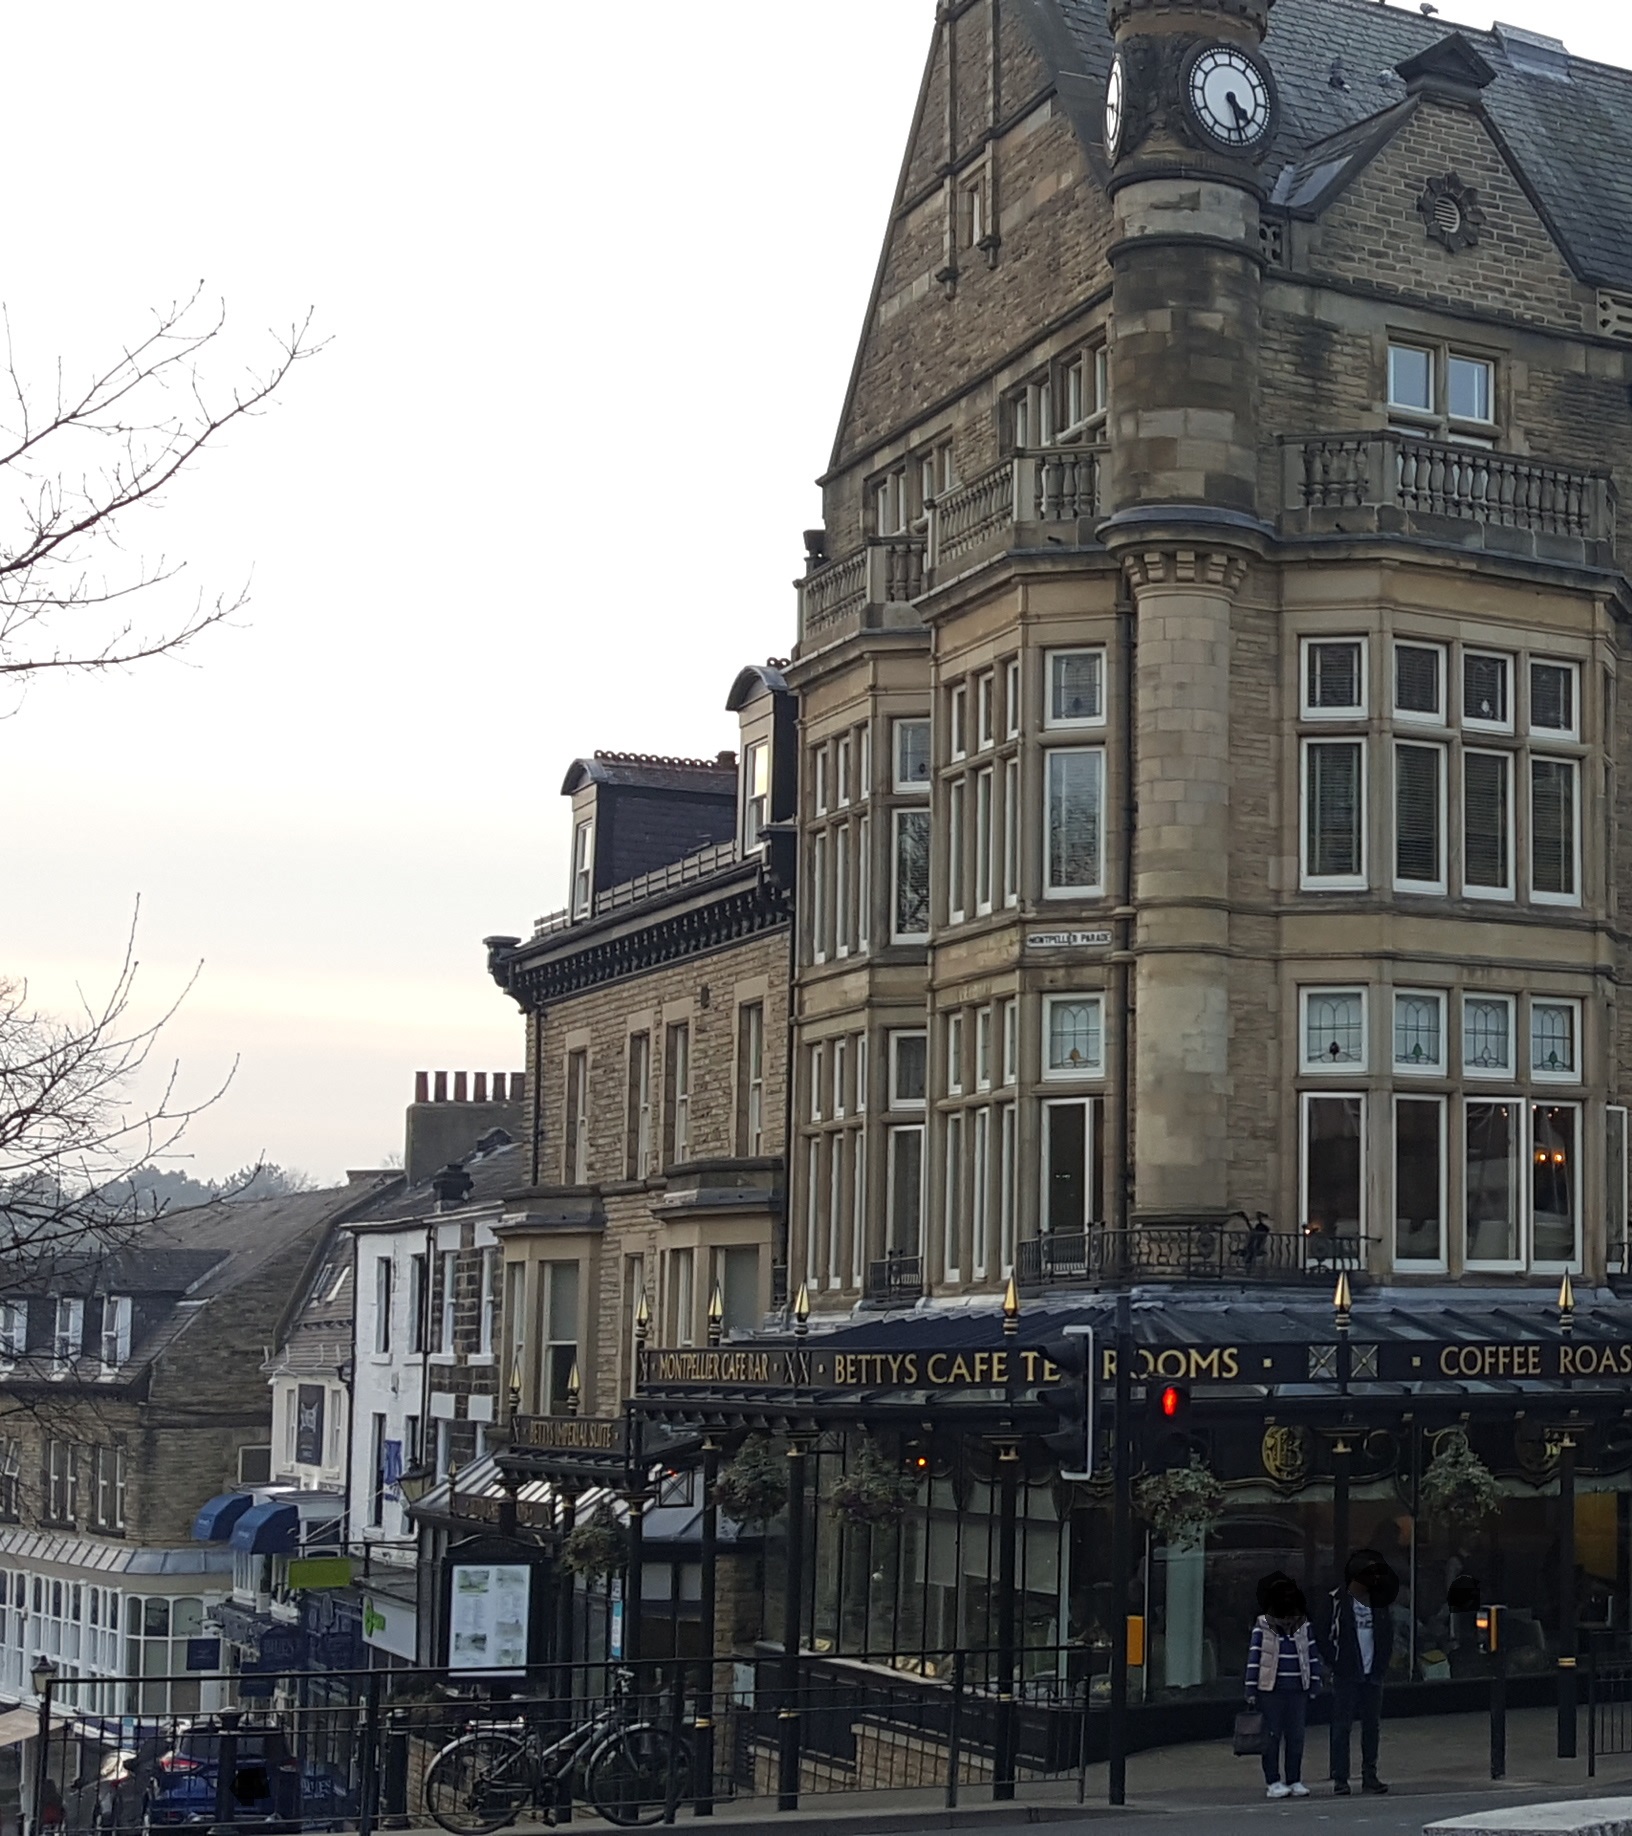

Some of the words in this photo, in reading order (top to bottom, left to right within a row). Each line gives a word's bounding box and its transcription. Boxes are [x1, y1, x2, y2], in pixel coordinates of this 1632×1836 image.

[659, 1353, 720, 1381] MONTPELLIER
[721, 1353, 746, 1381] CAFE
[749, 1353, 769, 1381] BAR
[834, 1353, 918, 1385] BETTYS
[927, 1351, 1009, 1383] CAFE
[1439, 1345, 1542, 1376] COFFEE
